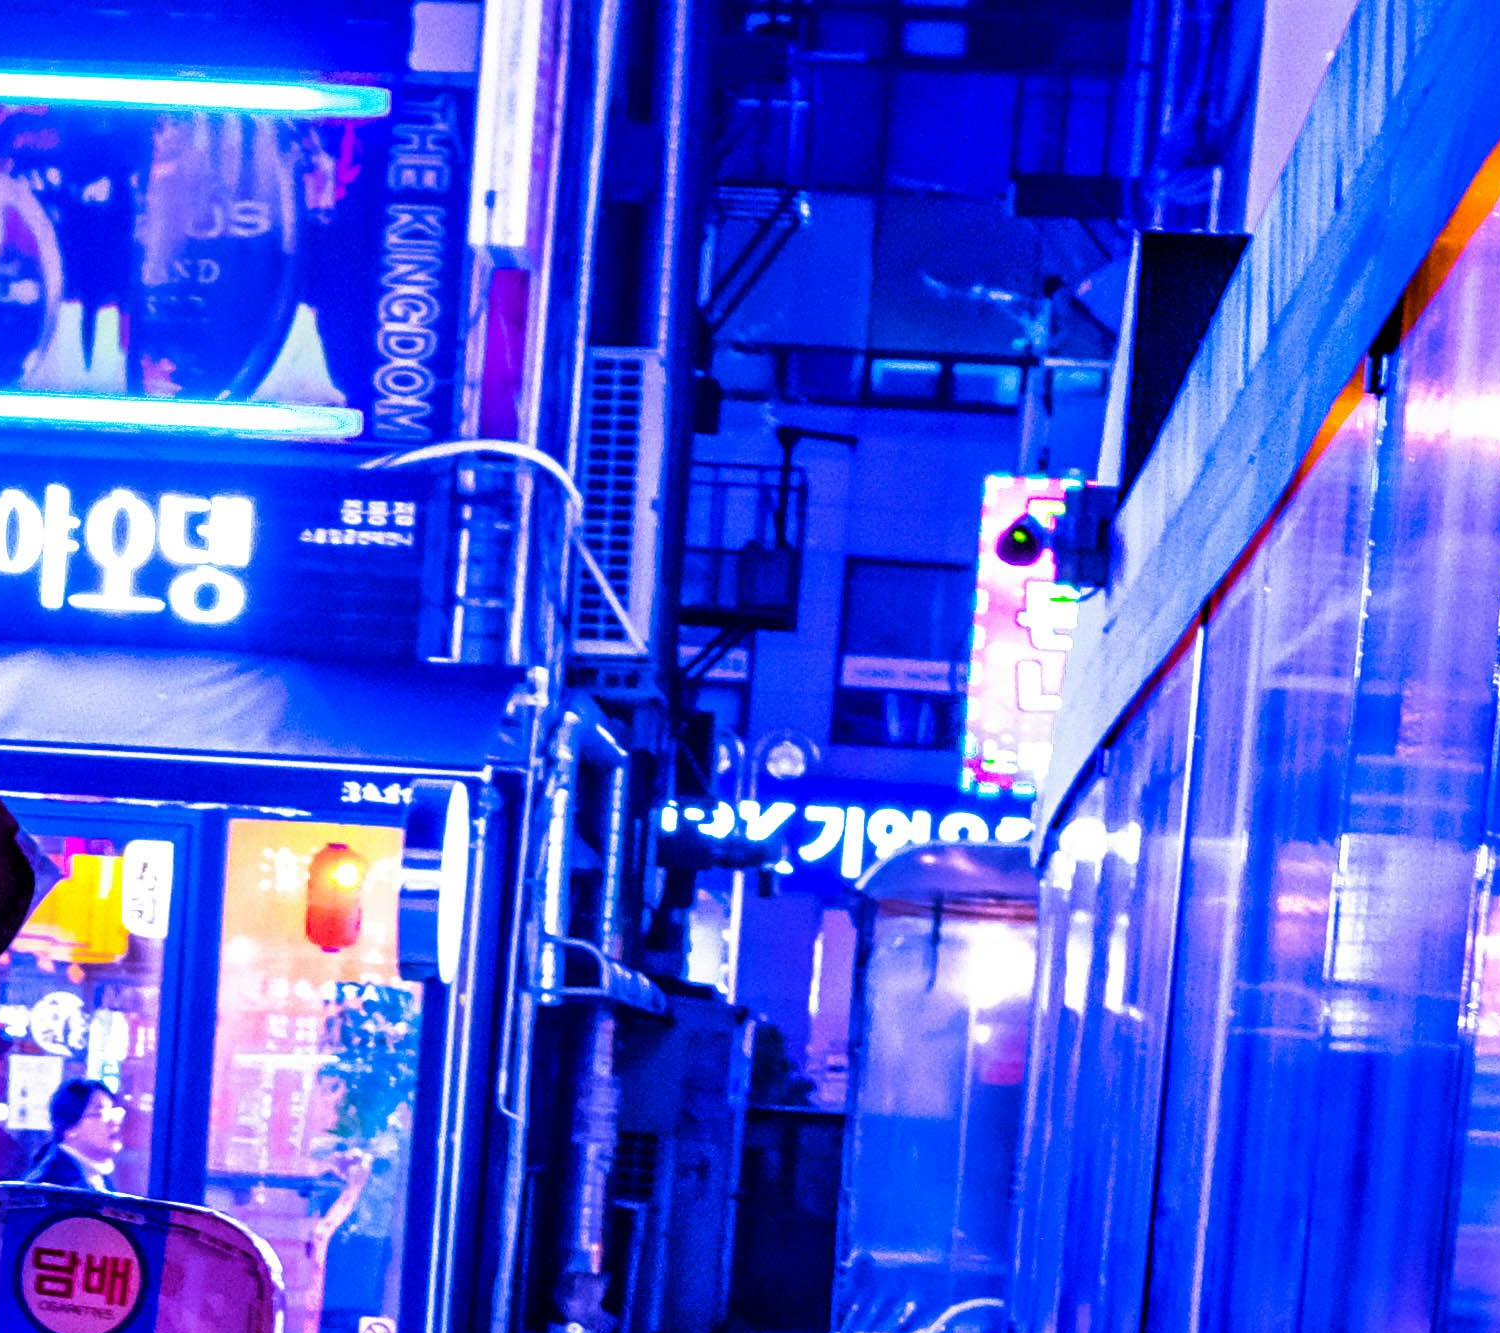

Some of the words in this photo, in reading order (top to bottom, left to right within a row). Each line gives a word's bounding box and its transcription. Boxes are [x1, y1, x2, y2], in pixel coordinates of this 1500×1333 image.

[387, 90, 452, 192] THE
[372, 203, 447, 440] KINGDOM
[32, 1246, 133, 1307] 담배
